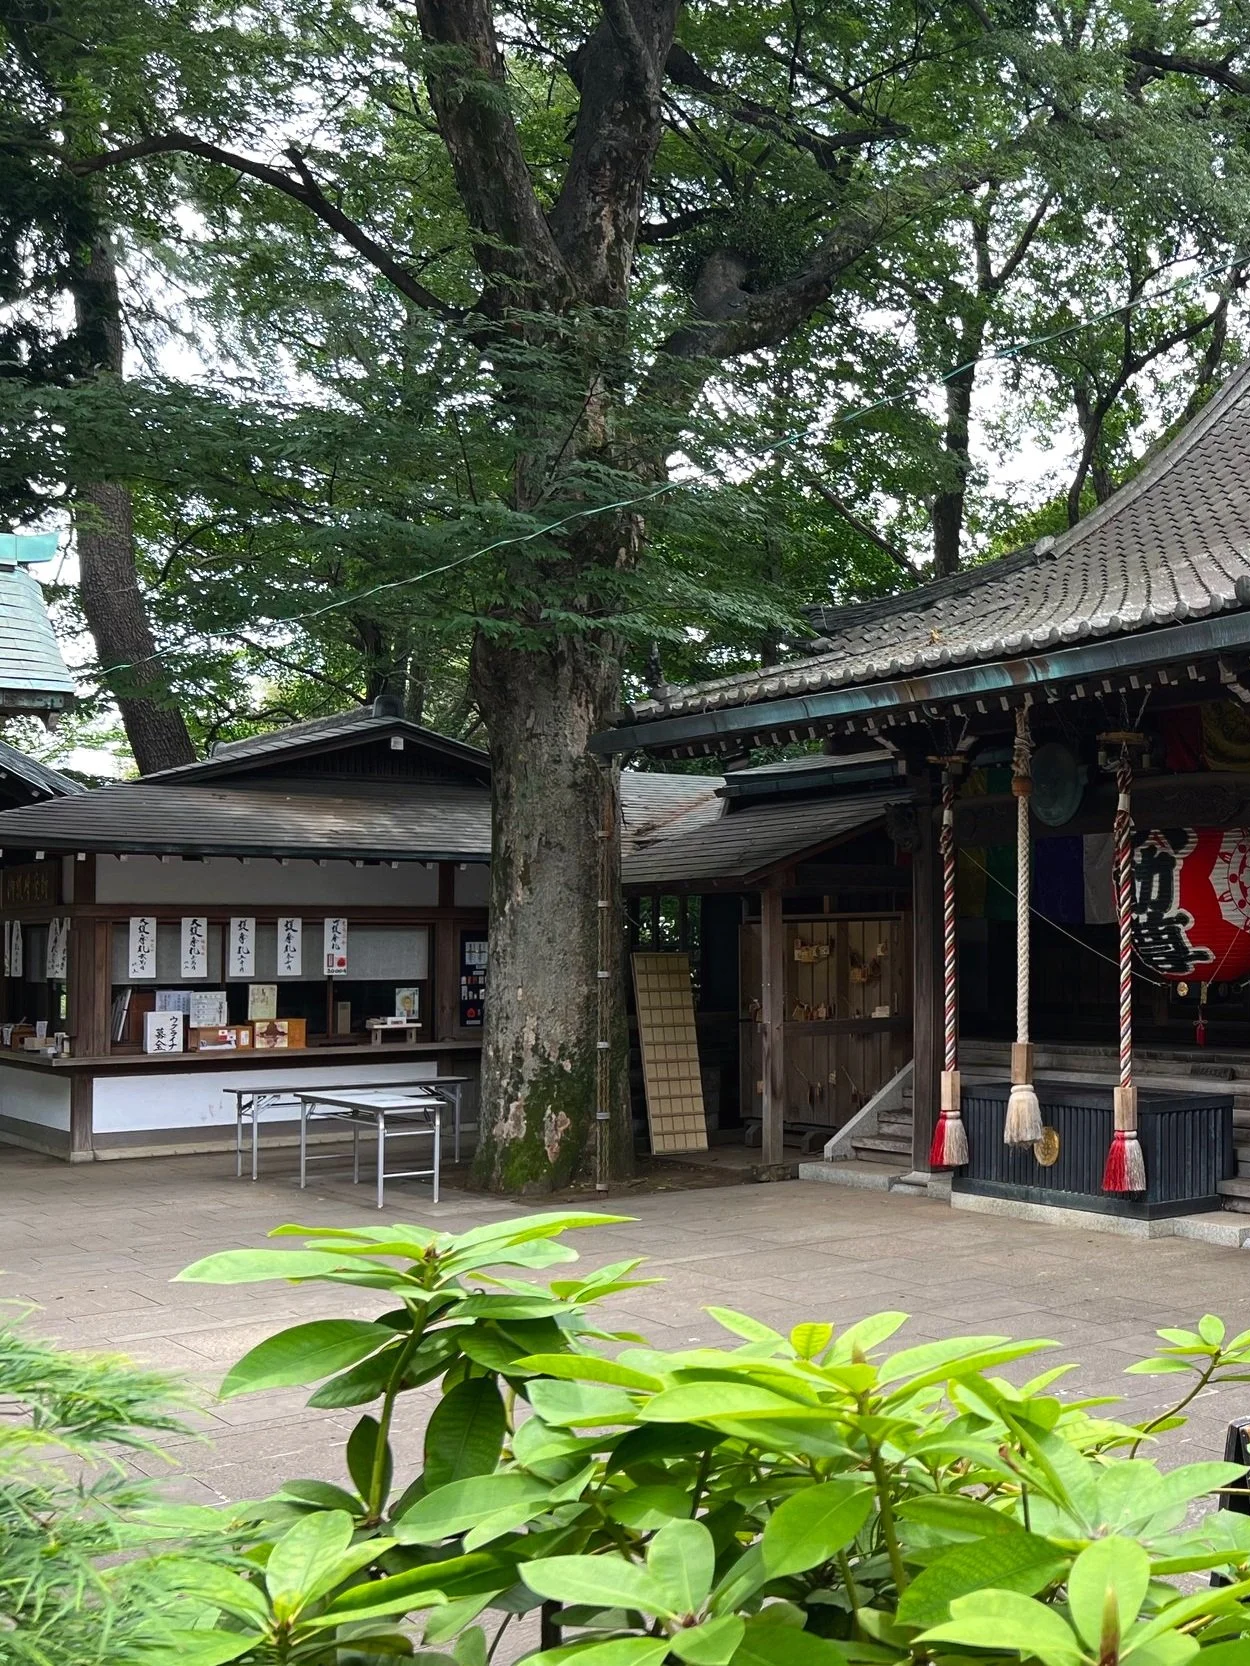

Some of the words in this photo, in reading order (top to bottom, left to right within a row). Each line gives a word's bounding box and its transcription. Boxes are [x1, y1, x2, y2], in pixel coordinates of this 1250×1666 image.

[153, 1027, 167, 1052] 募金
[168, 1015, 179, 1051] ウクライナ
